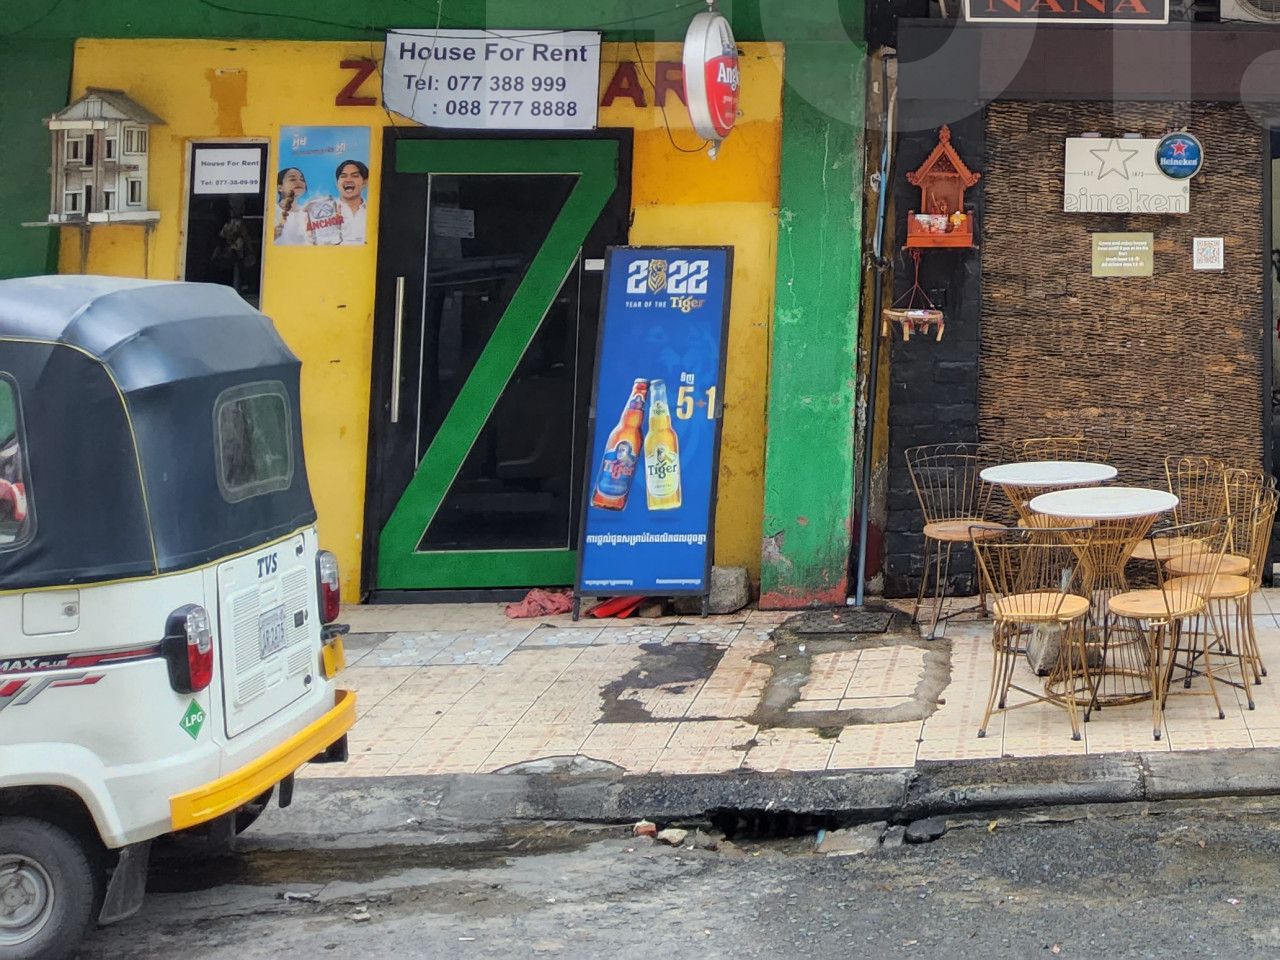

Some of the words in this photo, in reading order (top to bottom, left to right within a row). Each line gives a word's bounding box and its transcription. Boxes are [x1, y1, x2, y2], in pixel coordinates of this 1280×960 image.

[399, 41, 477, 63] House
[484, 42, 526, 63] For
[532, 43, 588, 63] Rent
[402, 74, 439, 92] Tel:
[447, 75, 482, 91] 077
[489, 75, 525, 92] 388
[531, 76, 567, 92] 999
[445, 100, 481, 117] 088
[488, 100, 523, 117] 777
[530, 101, 578, 117] 8888
[1159, 157, 1198, 166] Heineken
[670, 295, 706, 314] Tiger
[647, 461, 678, 480] Tiger
[256, 552, 278, 579] TVS
[184, 711, 204, 728] LPG
